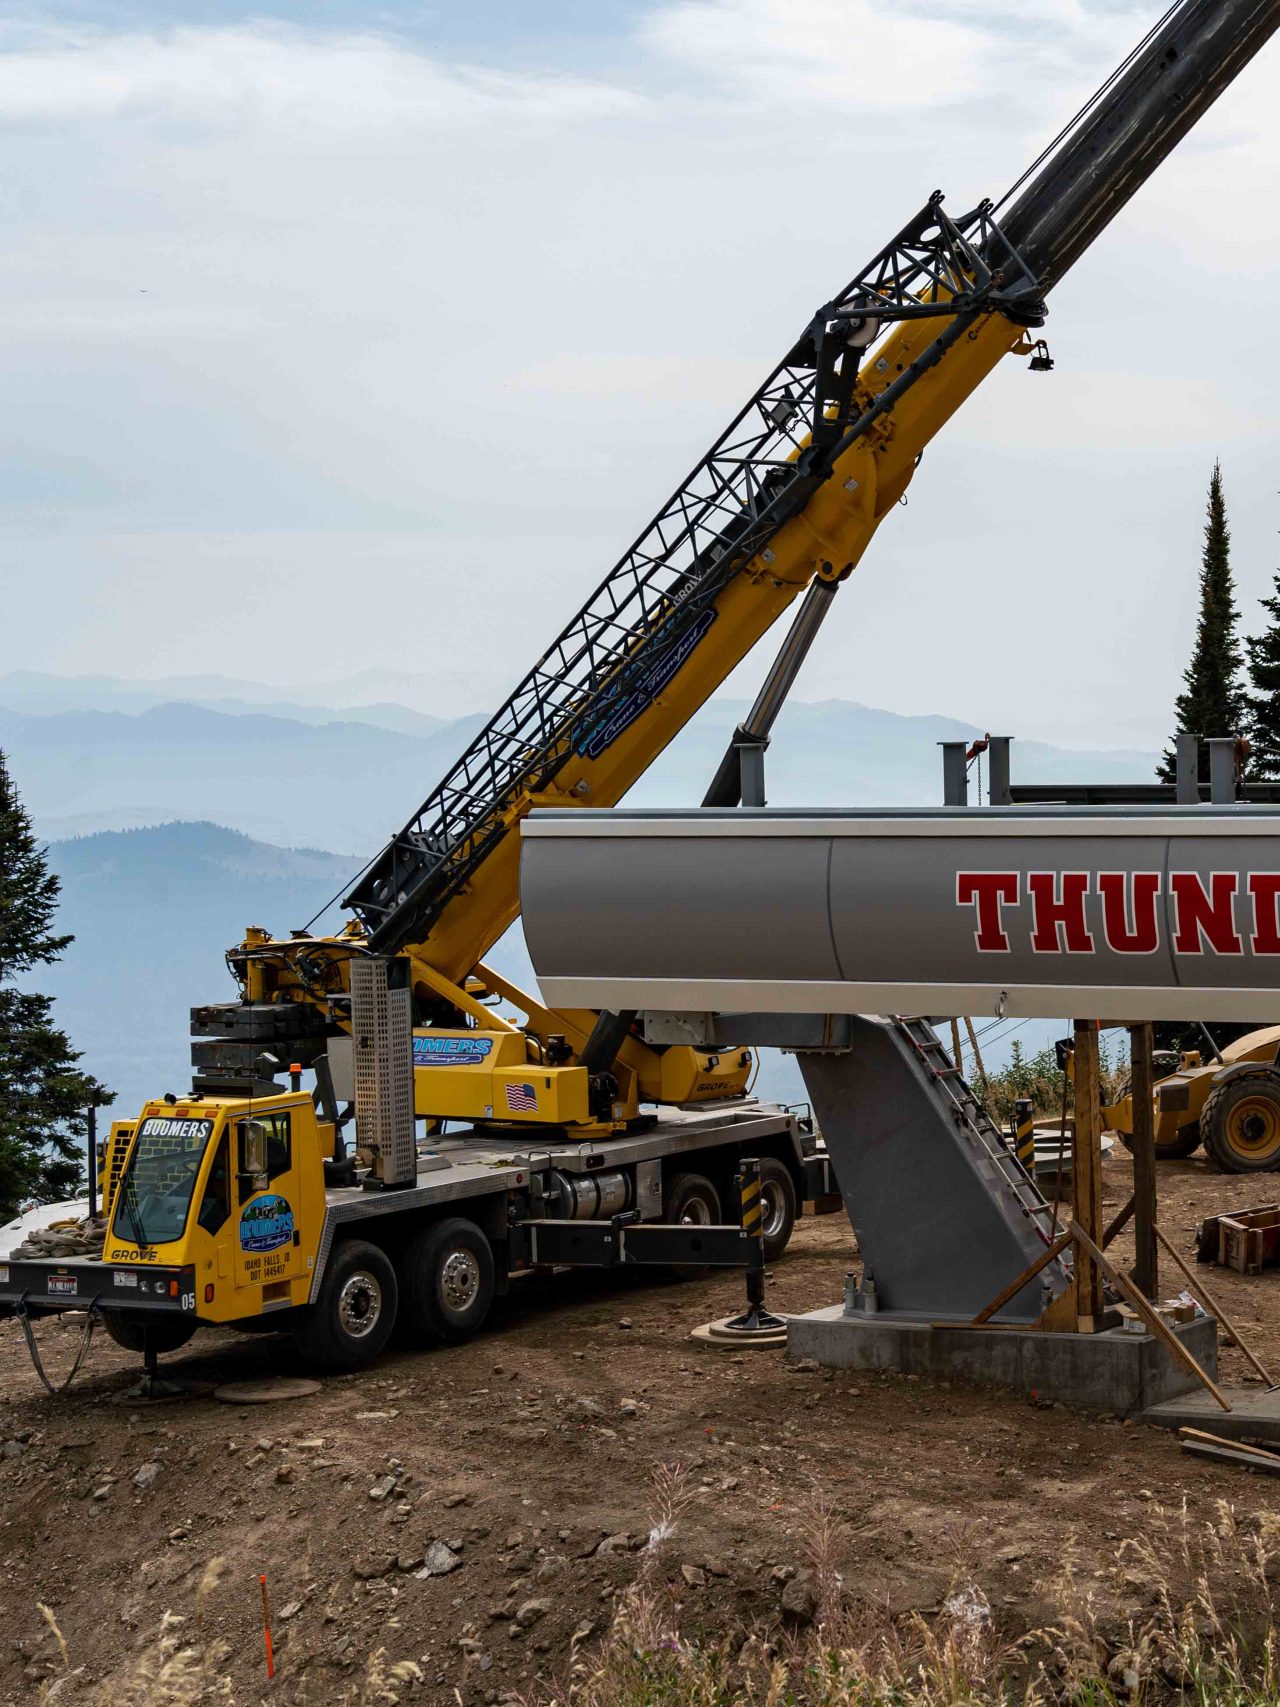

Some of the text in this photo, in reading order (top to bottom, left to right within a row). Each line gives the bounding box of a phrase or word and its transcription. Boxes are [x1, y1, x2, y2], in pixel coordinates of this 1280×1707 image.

[413, 1038, 492, 1055] OMERS
[142, 1119, 209, 1138] BOOMERS
[111, 1248, 158, 1261] GROVE
[245, 1258, 261, 1270] IDAHO
[250, 1269, 261, 1281] DOT
[181, 1292, 195, 1310] 05
